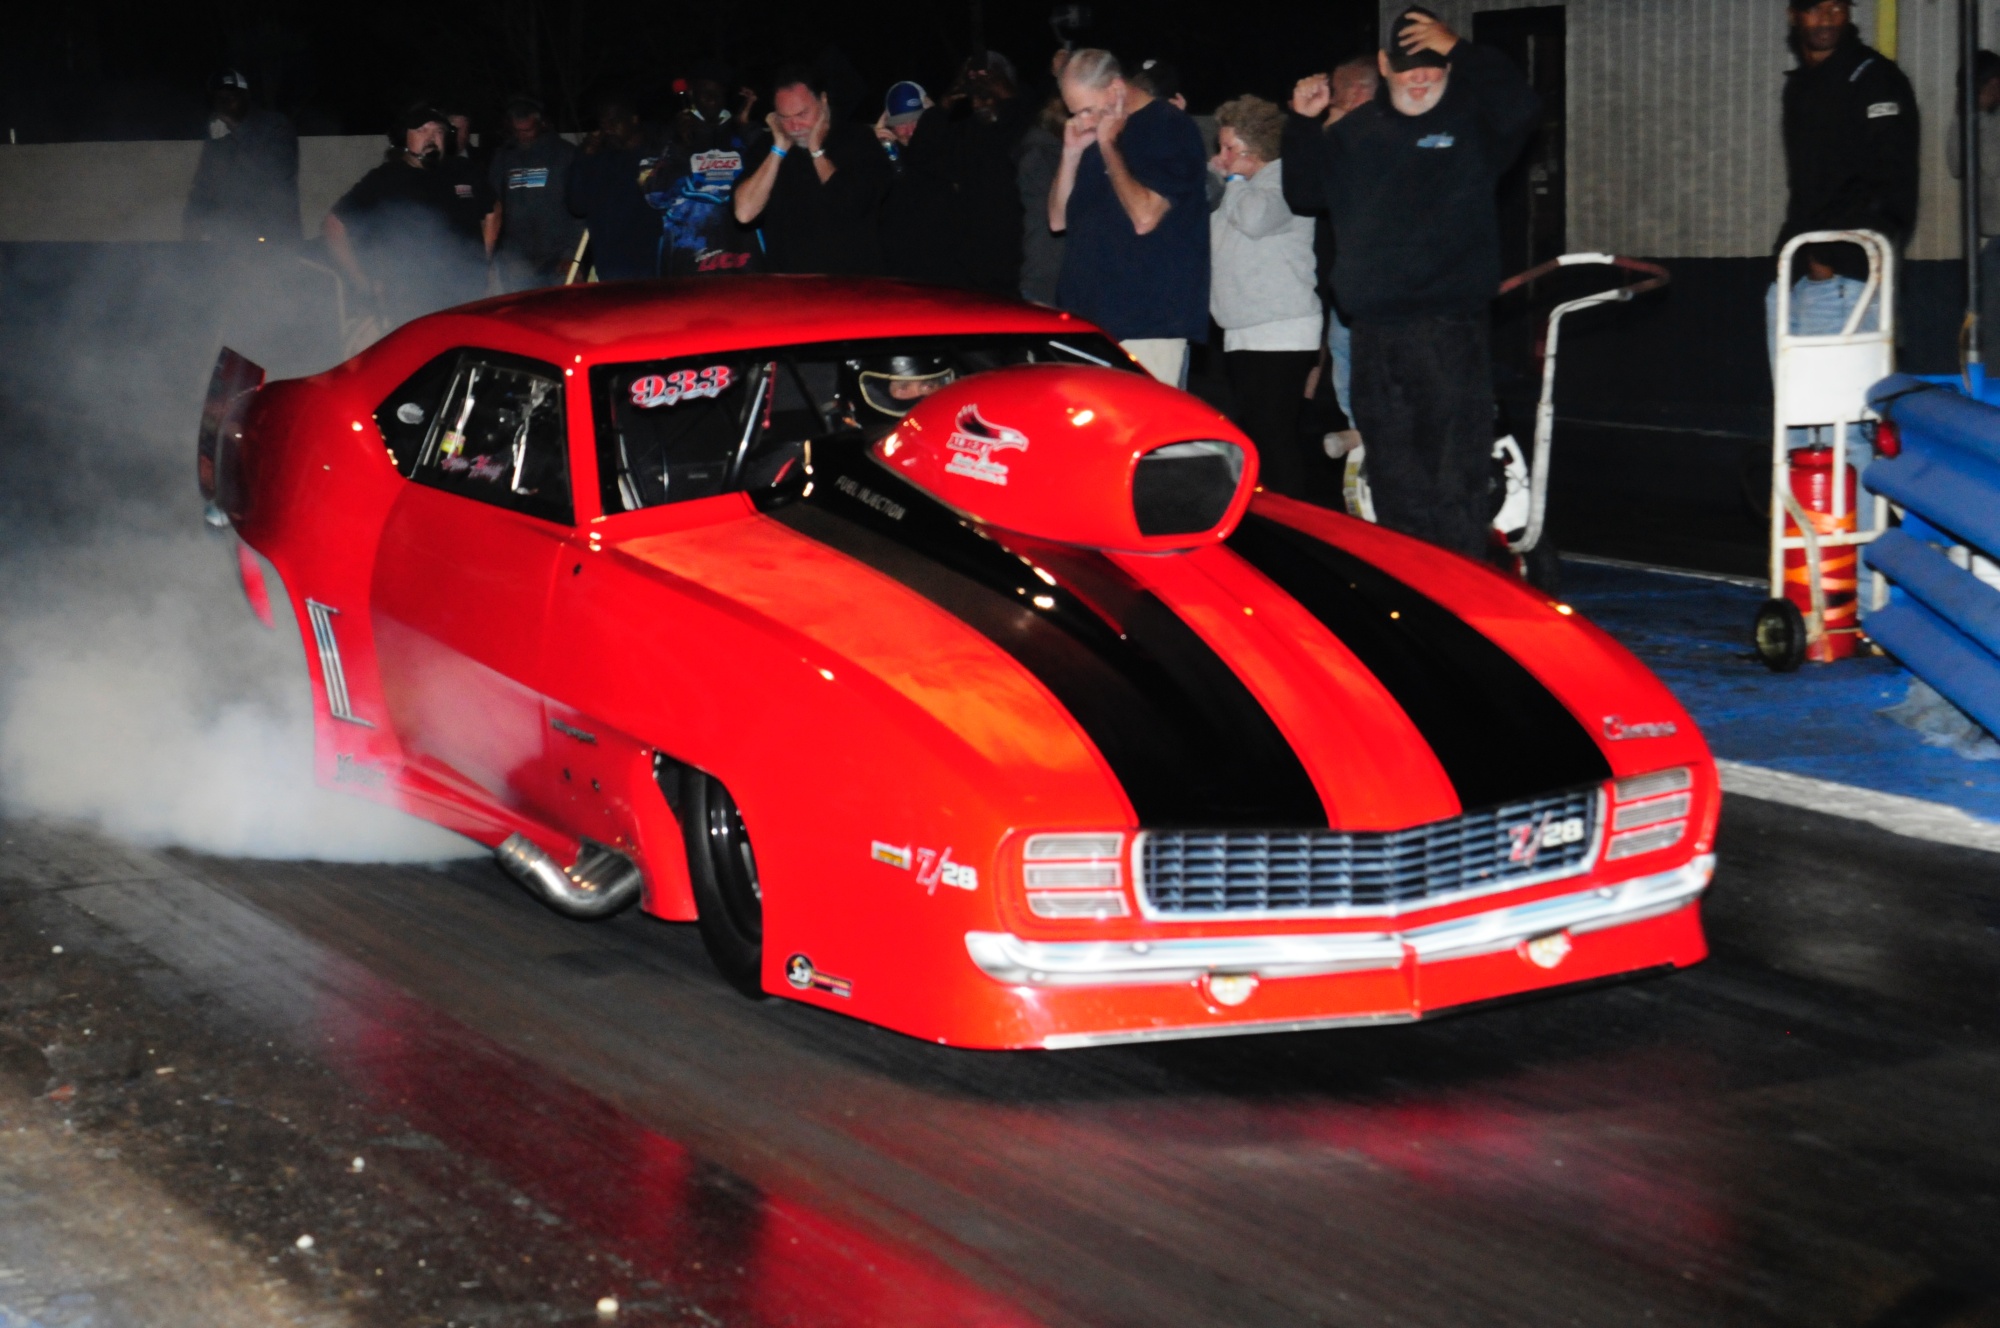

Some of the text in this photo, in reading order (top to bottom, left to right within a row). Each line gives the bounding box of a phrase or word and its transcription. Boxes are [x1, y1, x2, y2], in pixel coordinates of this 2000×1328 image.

[698, 159, 738, 171] LUCAS
[630, 365, 731, 404] 933
[834, 475, 906, 520] FUEL INJECTION
[1508, 811, 1584, 867] Z/28
[916, 846, 978, 895] Z/28
